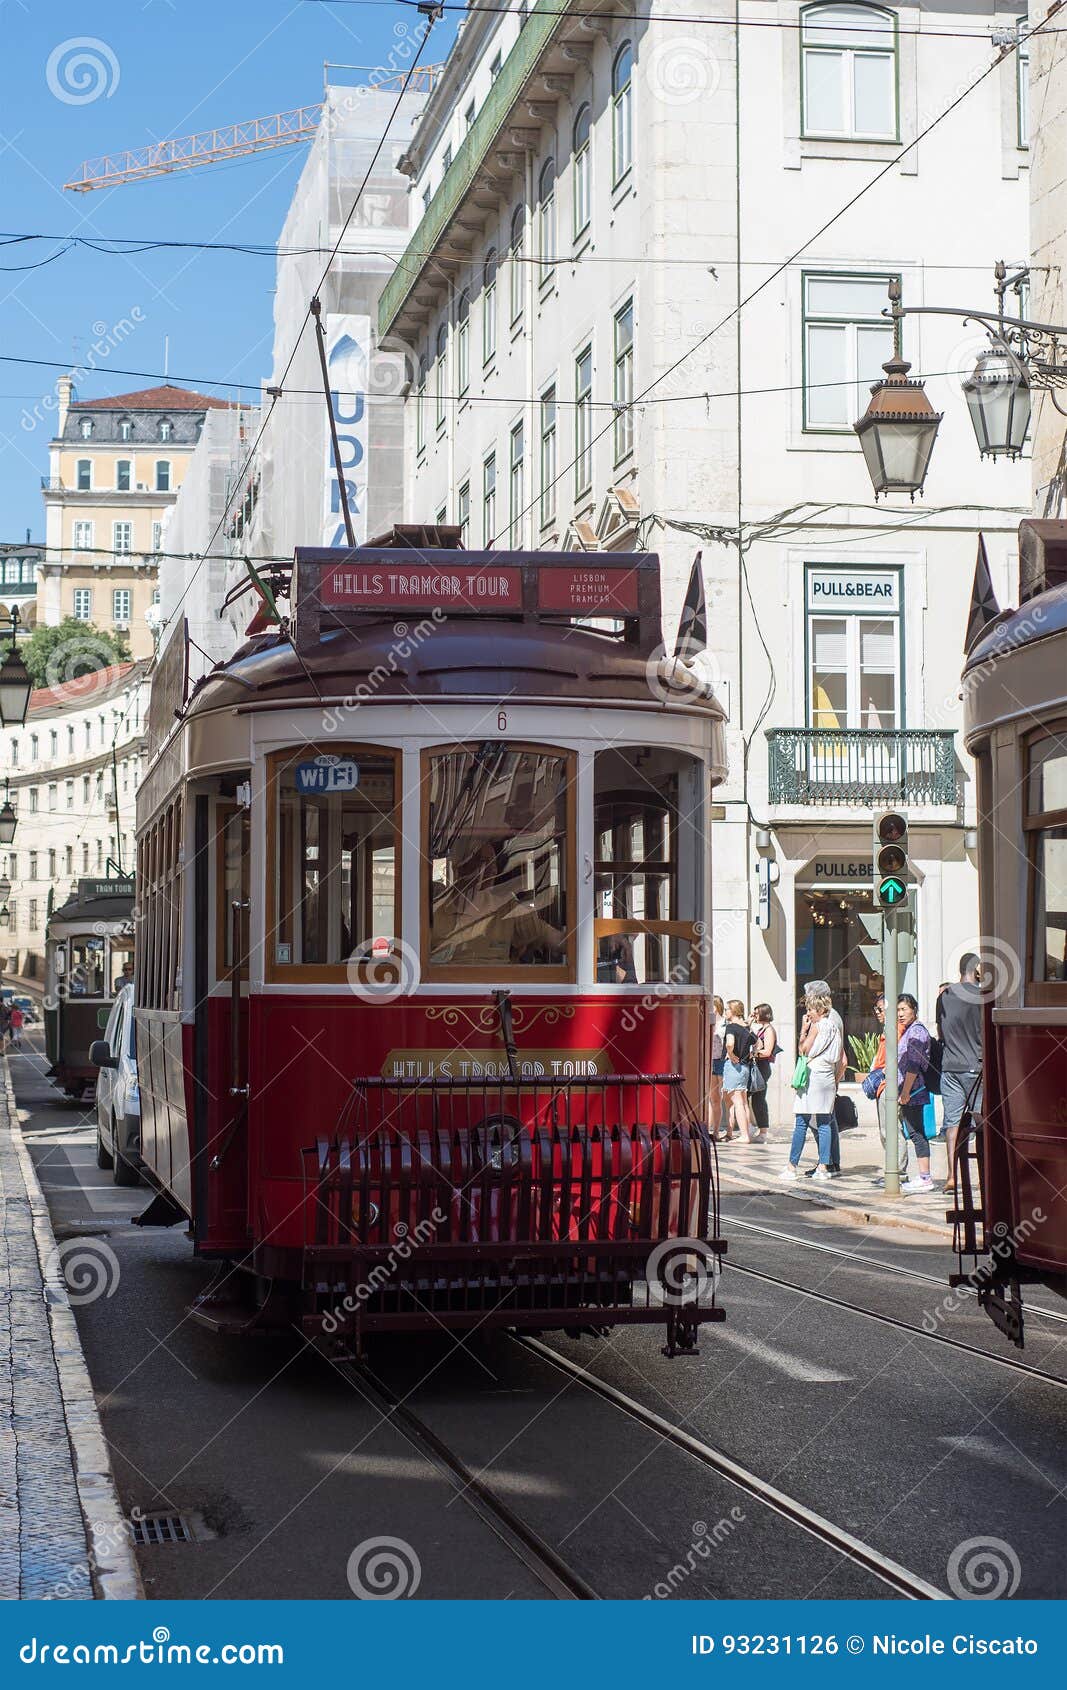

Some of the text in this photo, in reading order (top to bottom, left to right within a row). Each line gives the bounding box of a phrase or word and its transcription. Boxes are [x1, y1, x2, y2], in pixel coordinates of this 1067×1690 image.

[333, 574, 510, 596] HILLS TRAMCAR TOUR
[573, 574, 606, 582] LISBON
[570, 585, 610, 593] PREMIUM
[813, 582, 893, 597] PULL&BEAR
[571, 595, 610, 603] TRAMCAR
[498, 711, 507, 730] 6
[815, 863, 873, 877] PULL&BE
[96, 884, 132, 893] TRAM TOUR
[459, 1061, 545, 1077] TRAMAR
